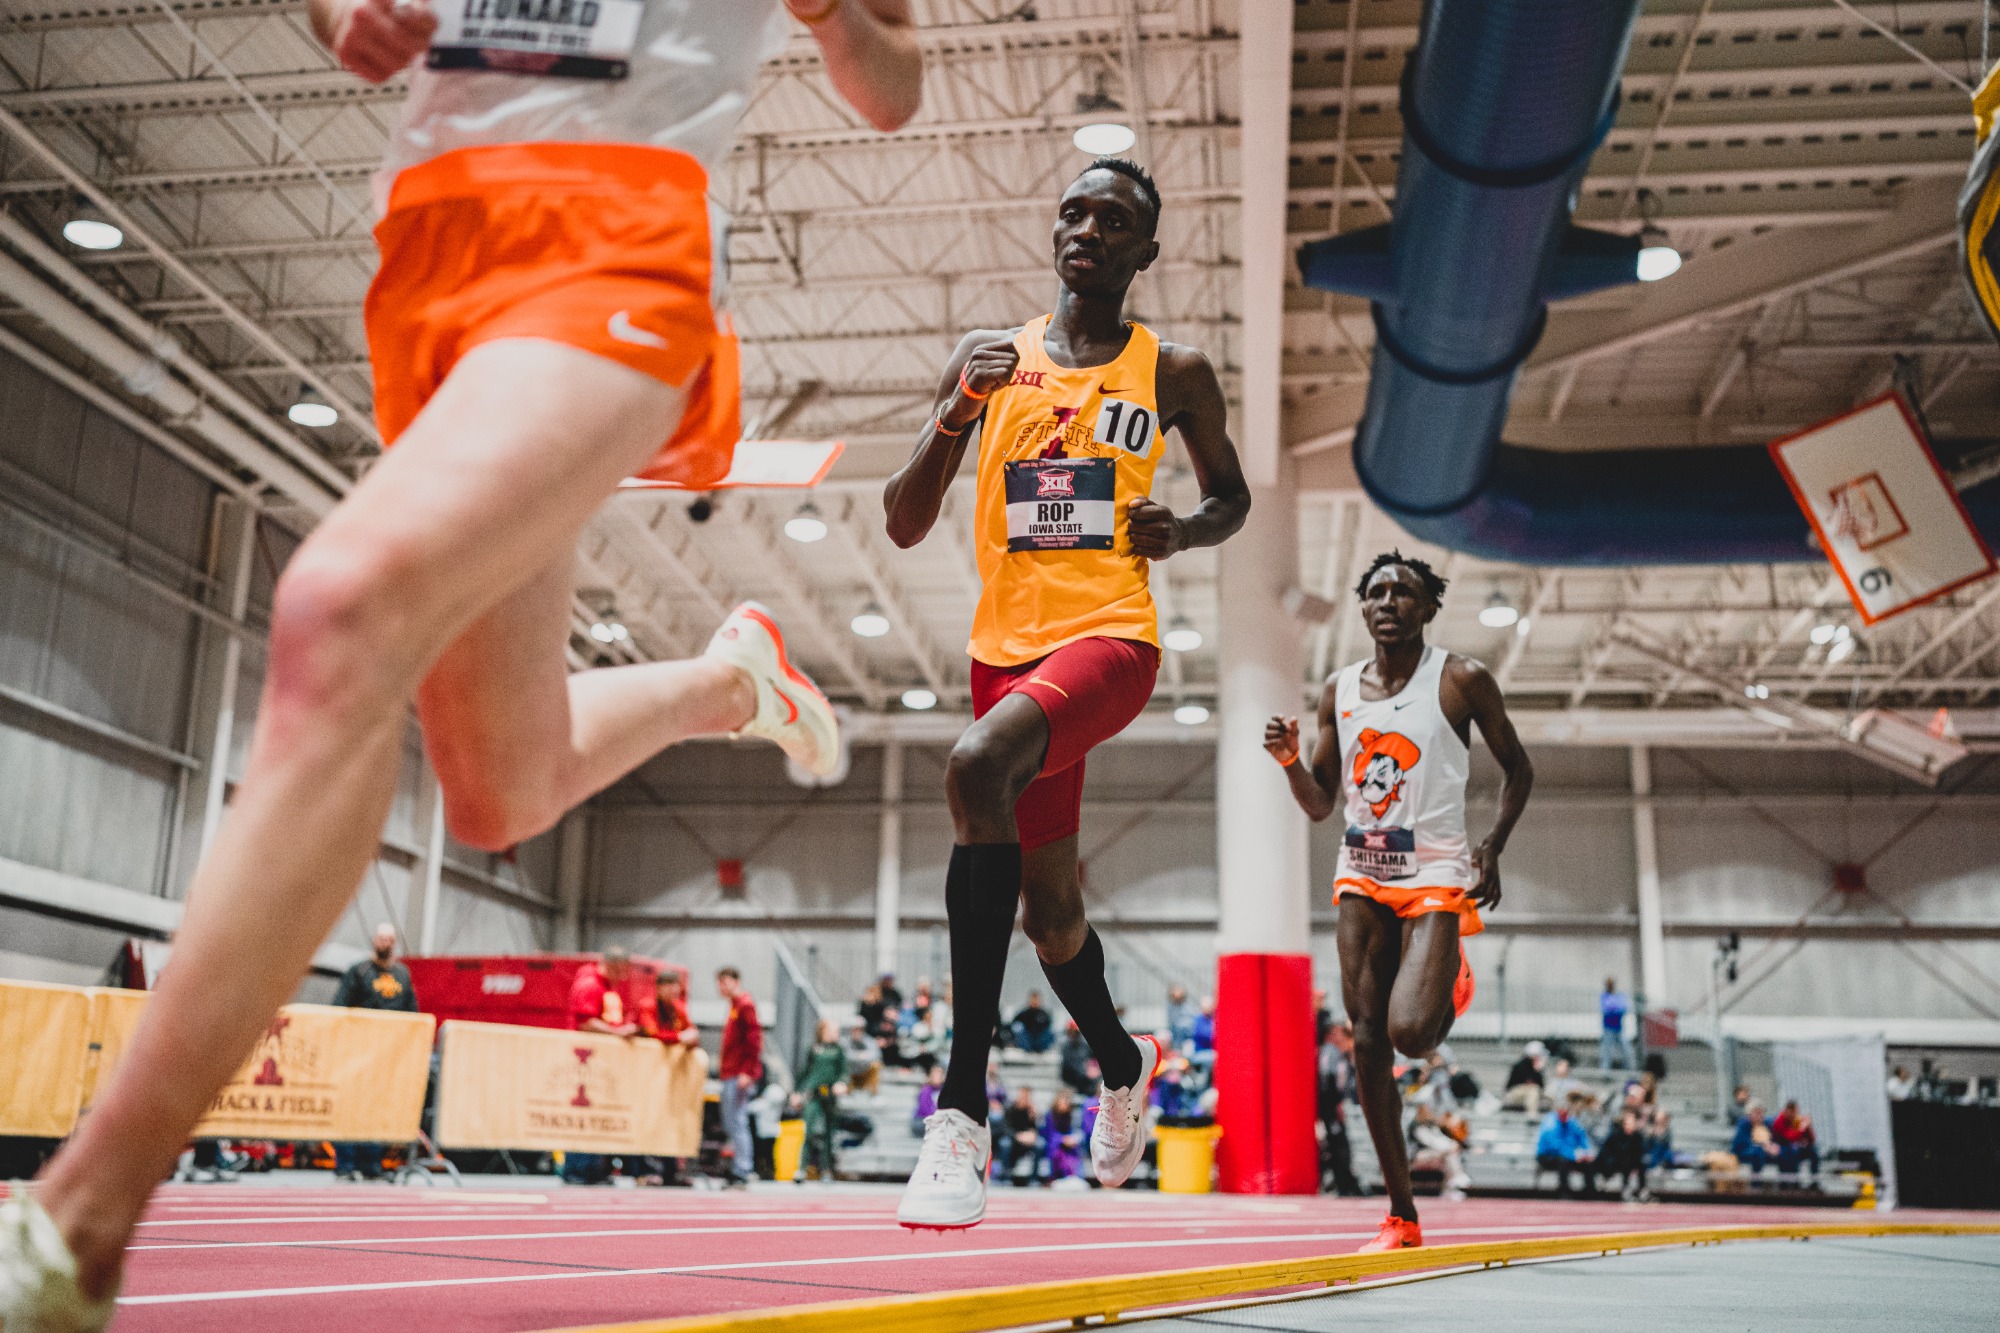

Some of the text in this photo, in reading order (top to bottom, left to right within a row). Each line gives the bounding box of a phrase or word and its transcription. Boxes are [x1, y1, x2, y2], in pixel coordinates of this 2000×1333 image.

[463, 0, 600, 27] LEONARD
[1105, 401, 1150, 452] 10
[1016, 420, 1101, 457] STATE
[1037, 502, 1075, 522] ROP
[1028, 523, 1083, 535] IOWA STATE
[1350, 847, 1407, 867] SHITSAMA
[208, 1093, 258, 1112] RACK
